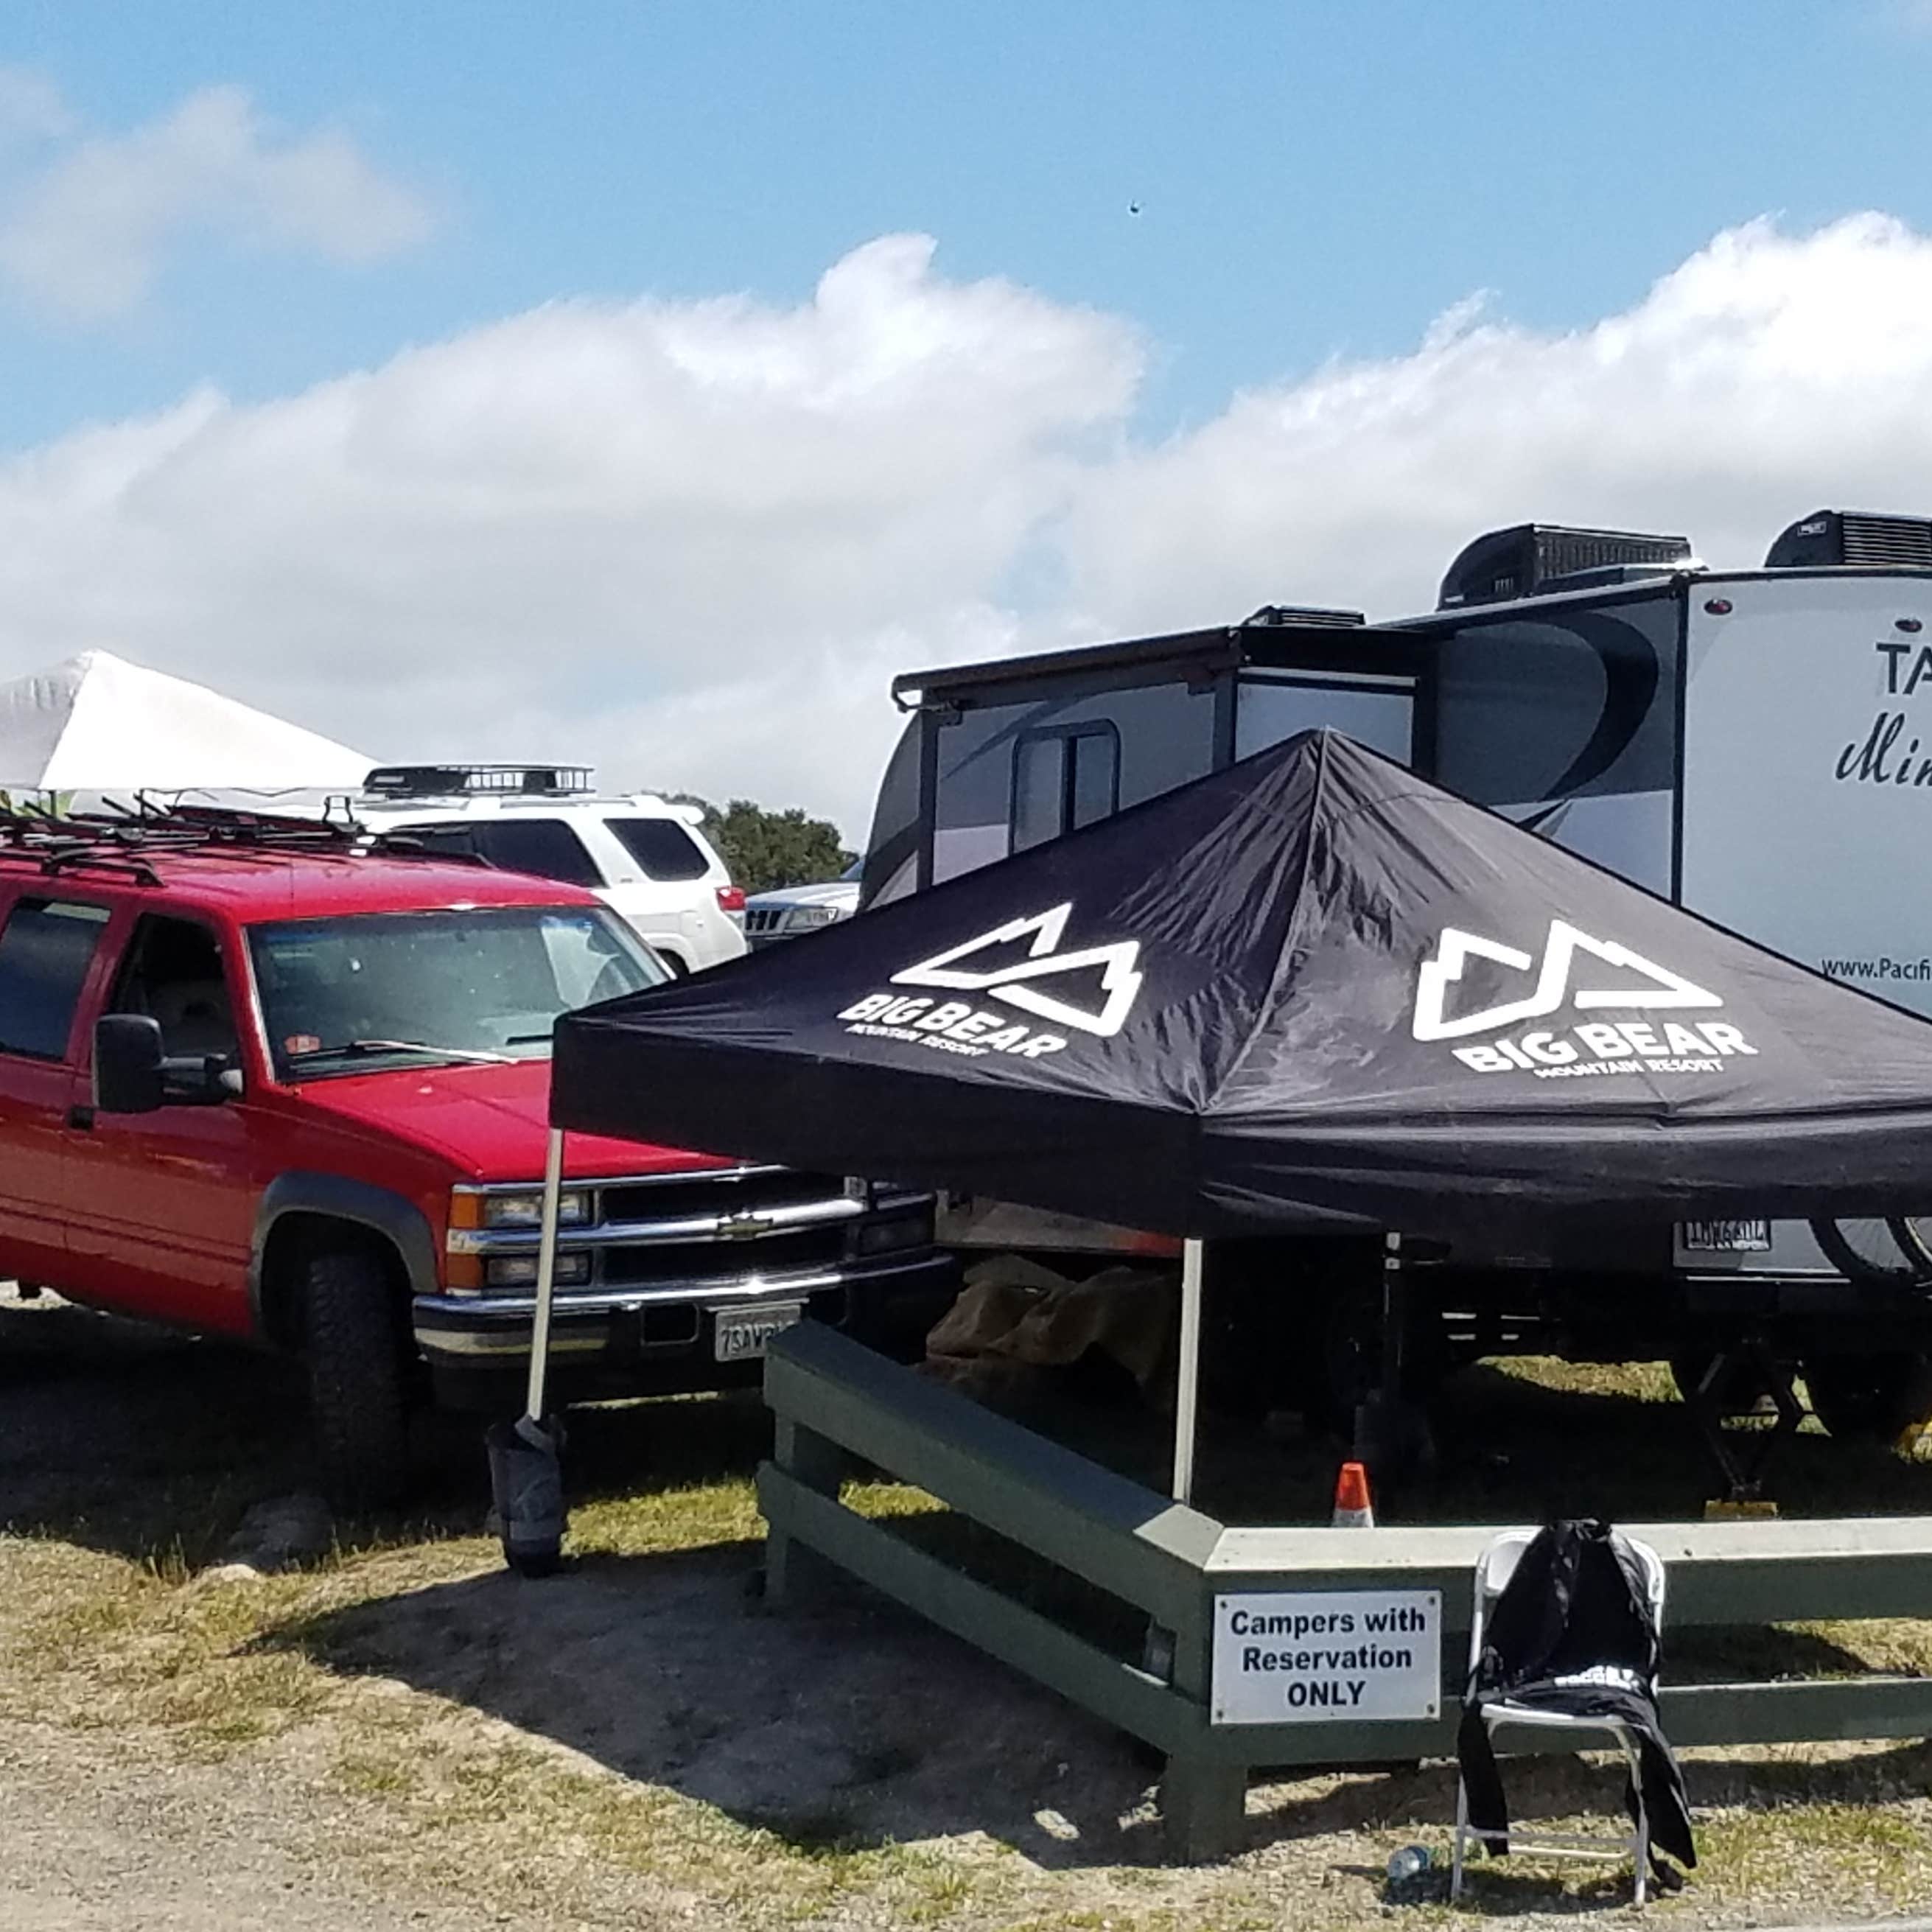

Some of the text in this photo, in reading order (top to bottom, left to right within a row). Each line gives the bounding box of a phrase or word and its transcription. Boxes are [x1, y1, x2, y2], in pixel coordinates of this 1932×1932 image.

[836, 994, 1067, 1057] BIG BEAR
[1452, 1023, 1759, 1072] BIG BEAR
[1533, 1059, 1724, 1079] MOUNTAIN RESORT
[1231, 1607, 1426, 1639] Campers with
[1242, 1643, 1413, 1672] Reservation
[1287, 1681, 1365, 1707] ONLY
